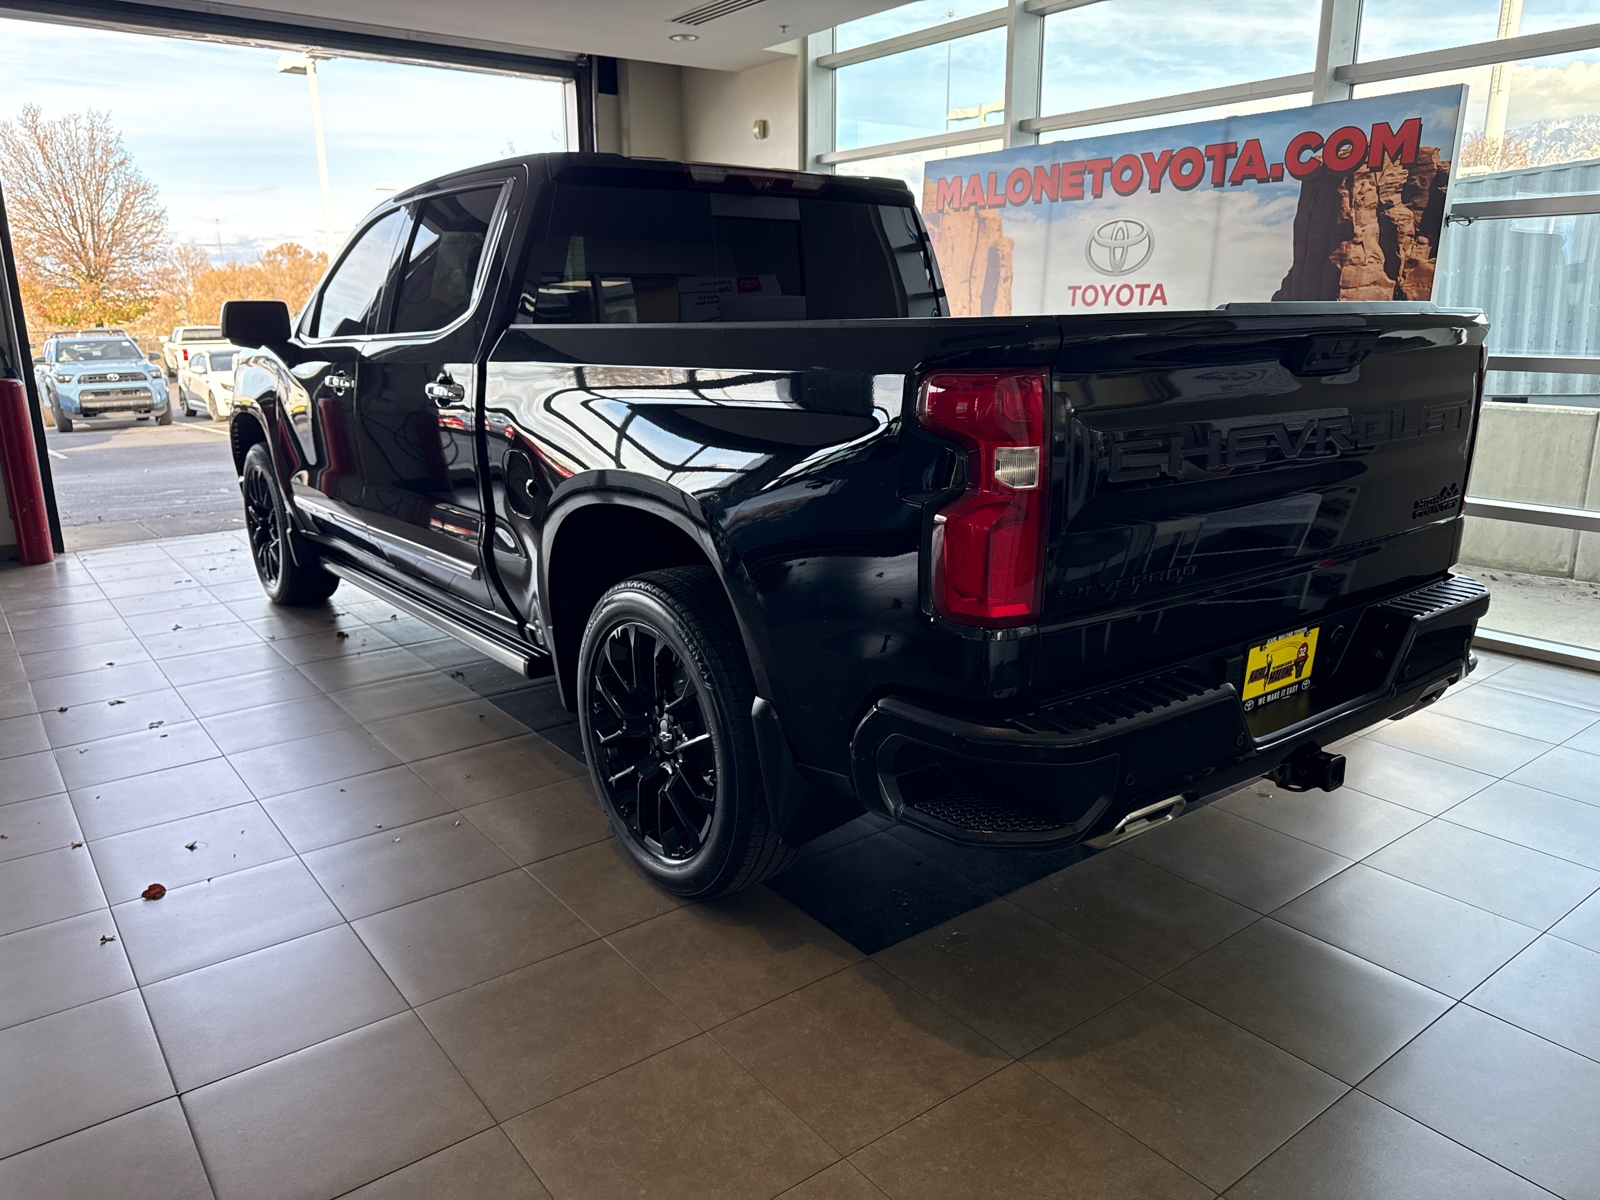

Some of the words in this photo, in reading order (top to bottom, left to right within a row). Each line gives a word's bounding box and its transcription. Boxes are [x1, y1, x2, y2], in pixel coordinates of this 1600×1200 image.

[936, 117, 1422, 213] MALONETOYOTA.COM
[1067, 283, 1168, 307] TOYOTA
[1108, 400, 1471, 483] CHEVROLET
[1411, 498, 1458, 520] COUNTRY
[1413, 495, 1440, 509] HIGH
[1057, 564, 1198, 599] SILVERADO
[1299, 647, 1306, 657] 32
[1258, 696, 1266, 706] WE
[1267, 691, 1280, 702] MAKE
[1280, 689, 1286, 697] IT
[1286, 684, 1299, 695] EASY
